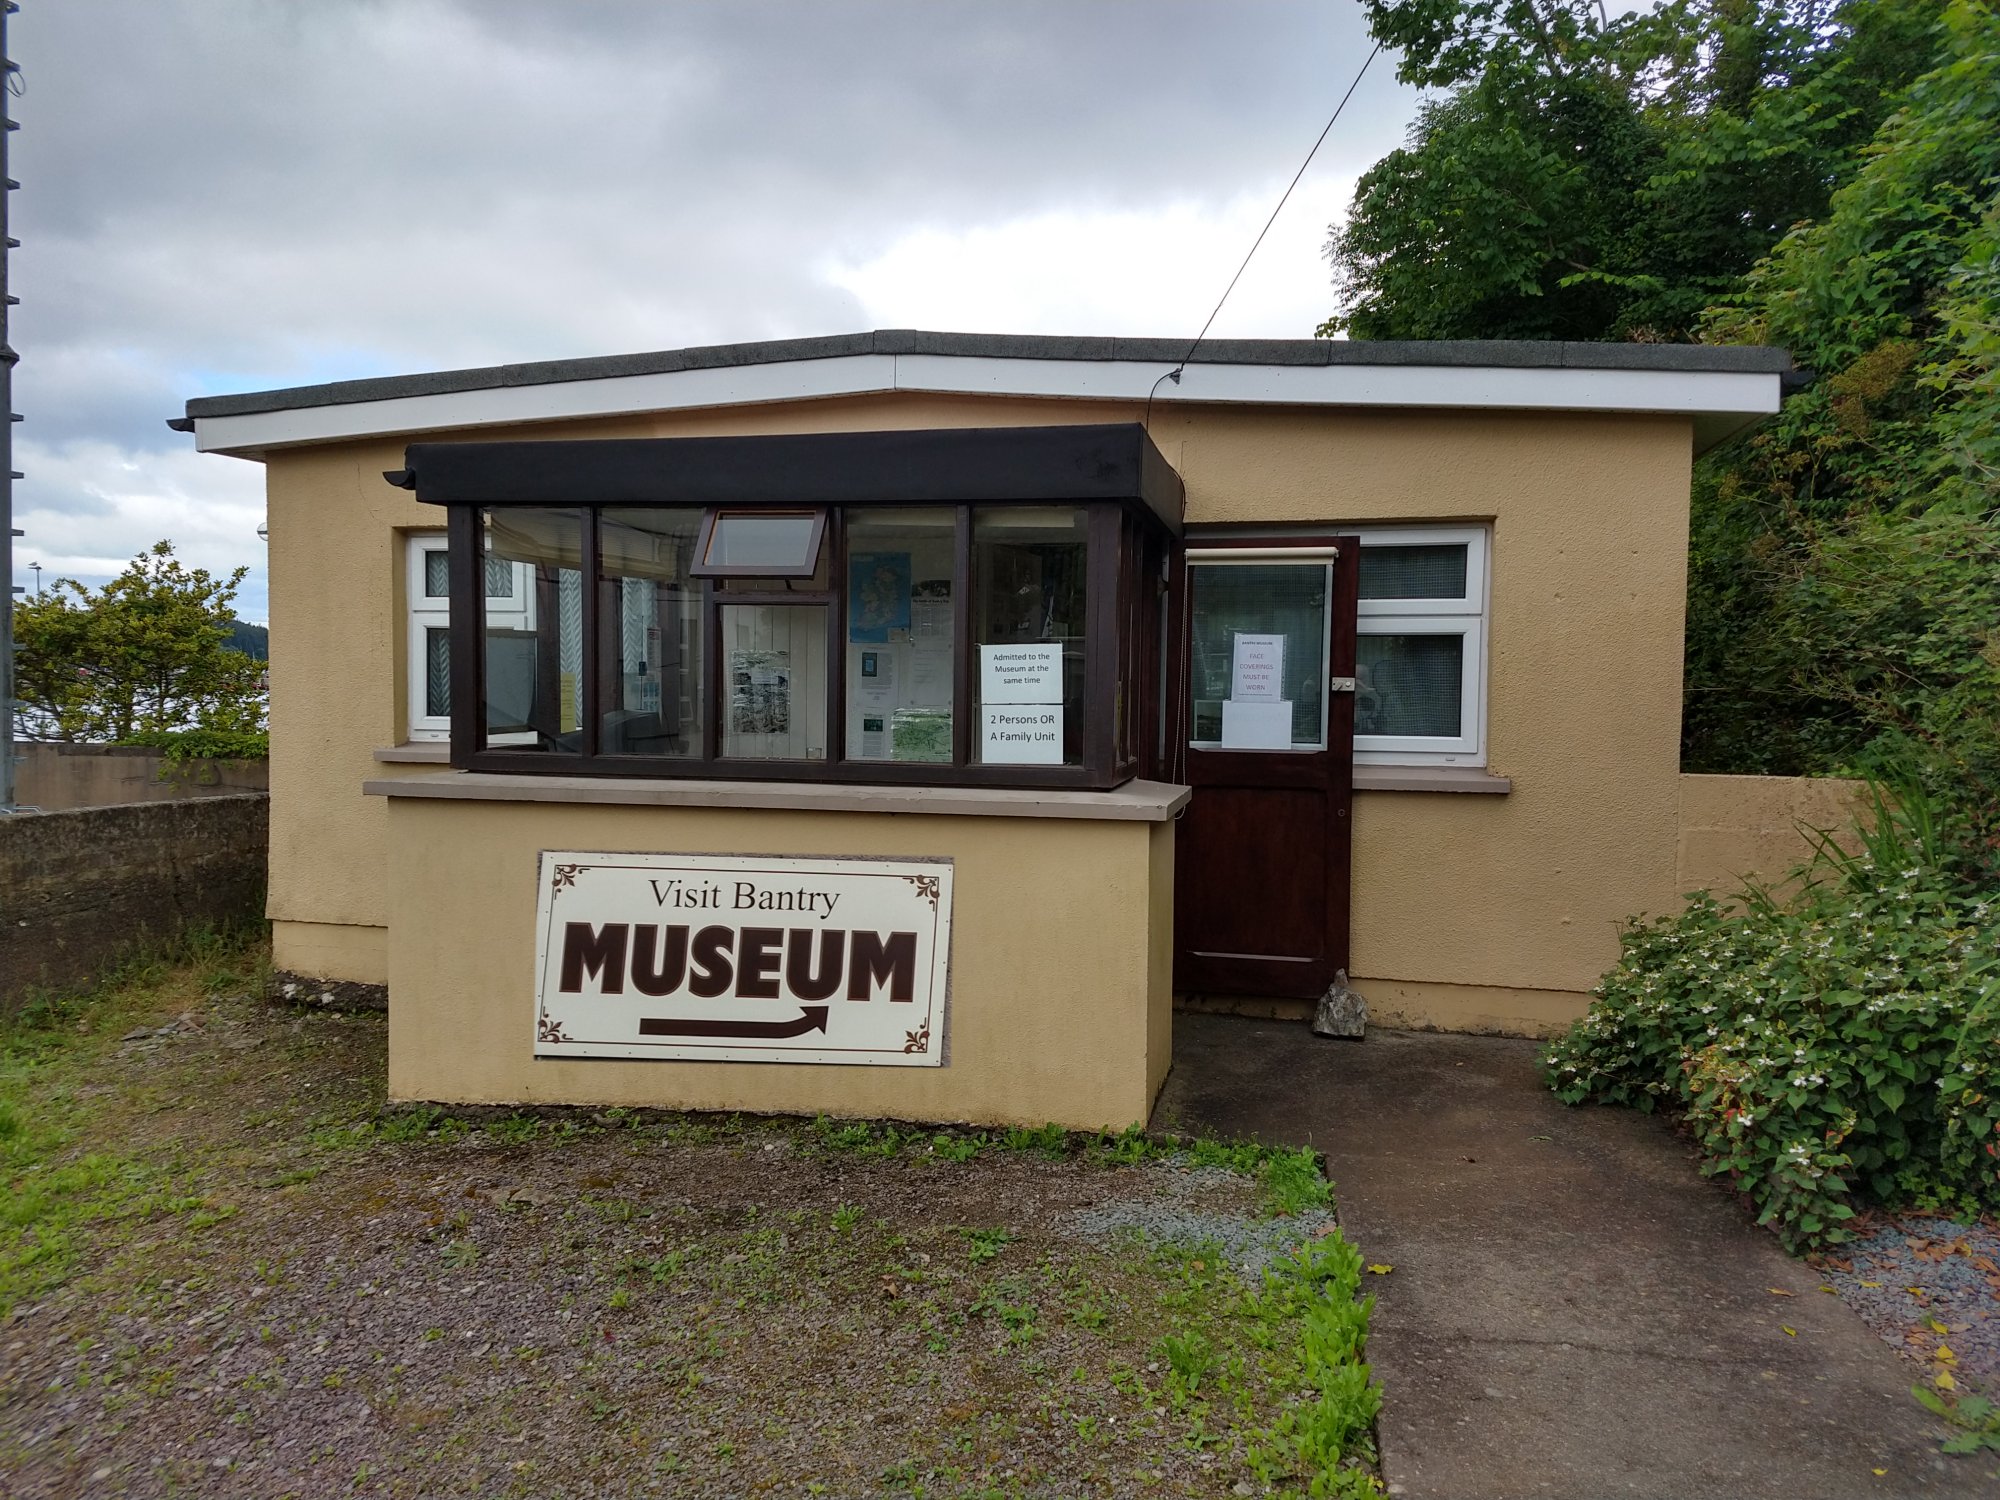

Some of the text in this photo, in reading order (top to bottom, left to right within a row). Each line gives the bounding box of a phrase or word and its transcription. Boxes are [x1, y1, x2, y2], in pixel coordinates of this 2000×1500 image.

[1037, 664, 1049, 672] the
[1024, 676, 1041, 684] time
[990, 714, 1055, 725] 2 Persons OR
[990, 731, 1056, 743] A Family Unit
[649, 878, 842, 920] Visit Bantry
[557, 920, 919, 1004] MUSEUM
